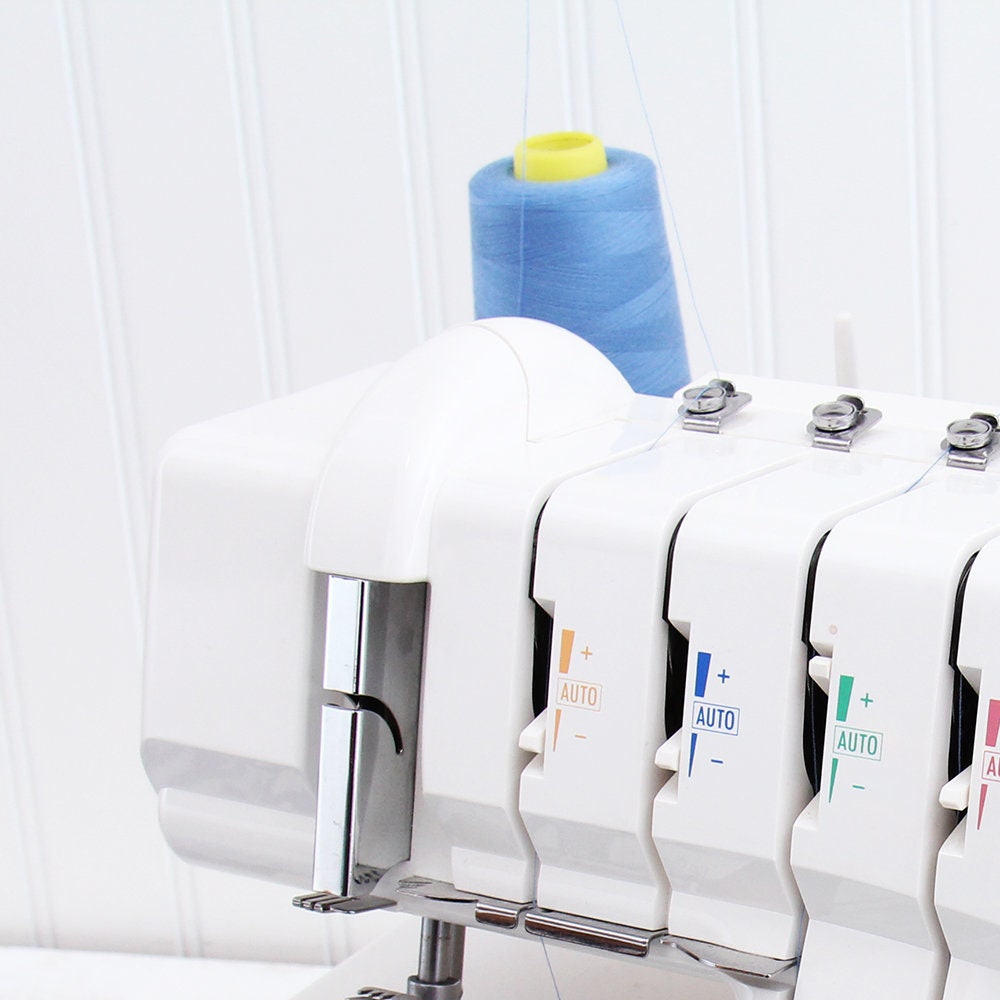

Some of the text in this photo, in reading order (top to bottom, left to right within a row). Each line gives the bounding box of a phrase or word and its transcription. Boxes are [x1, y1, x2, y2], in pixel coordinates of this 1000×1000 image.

[560, 682, 598, 707] AUTO
[696, 705, 736, 731] AUTO
[837, 730, 878, 756] AUTO
